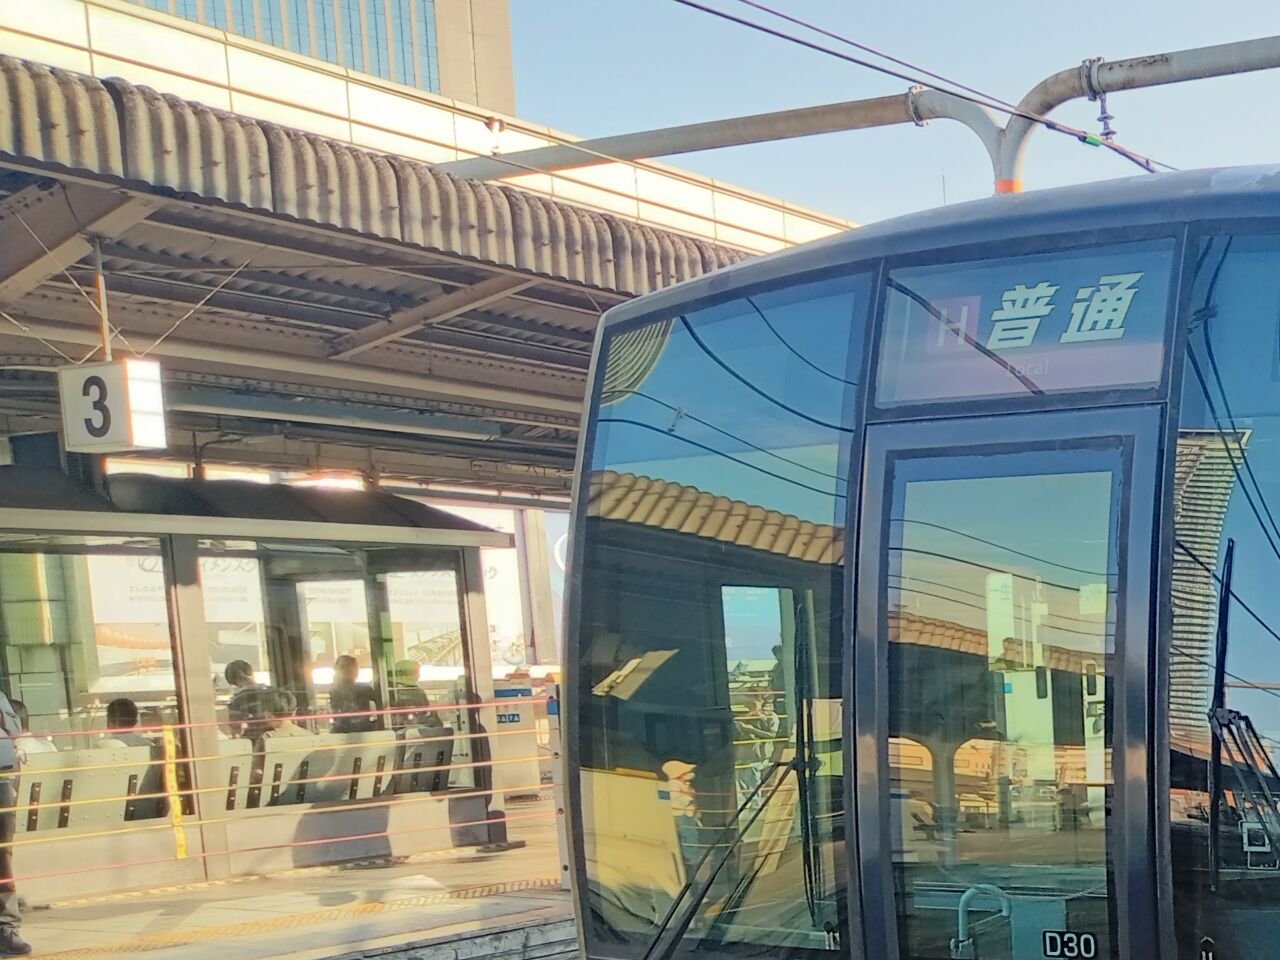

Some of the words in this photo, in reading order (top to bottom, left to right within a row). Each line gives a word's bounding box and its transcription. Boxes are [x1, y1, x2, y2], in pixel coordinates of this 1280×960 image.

[937, 305, 970, 349] H
[986, 271, 1145, 350] 普通
[82, 375, 112, 438] 3
[1046, 934, 1096, 958] D30
